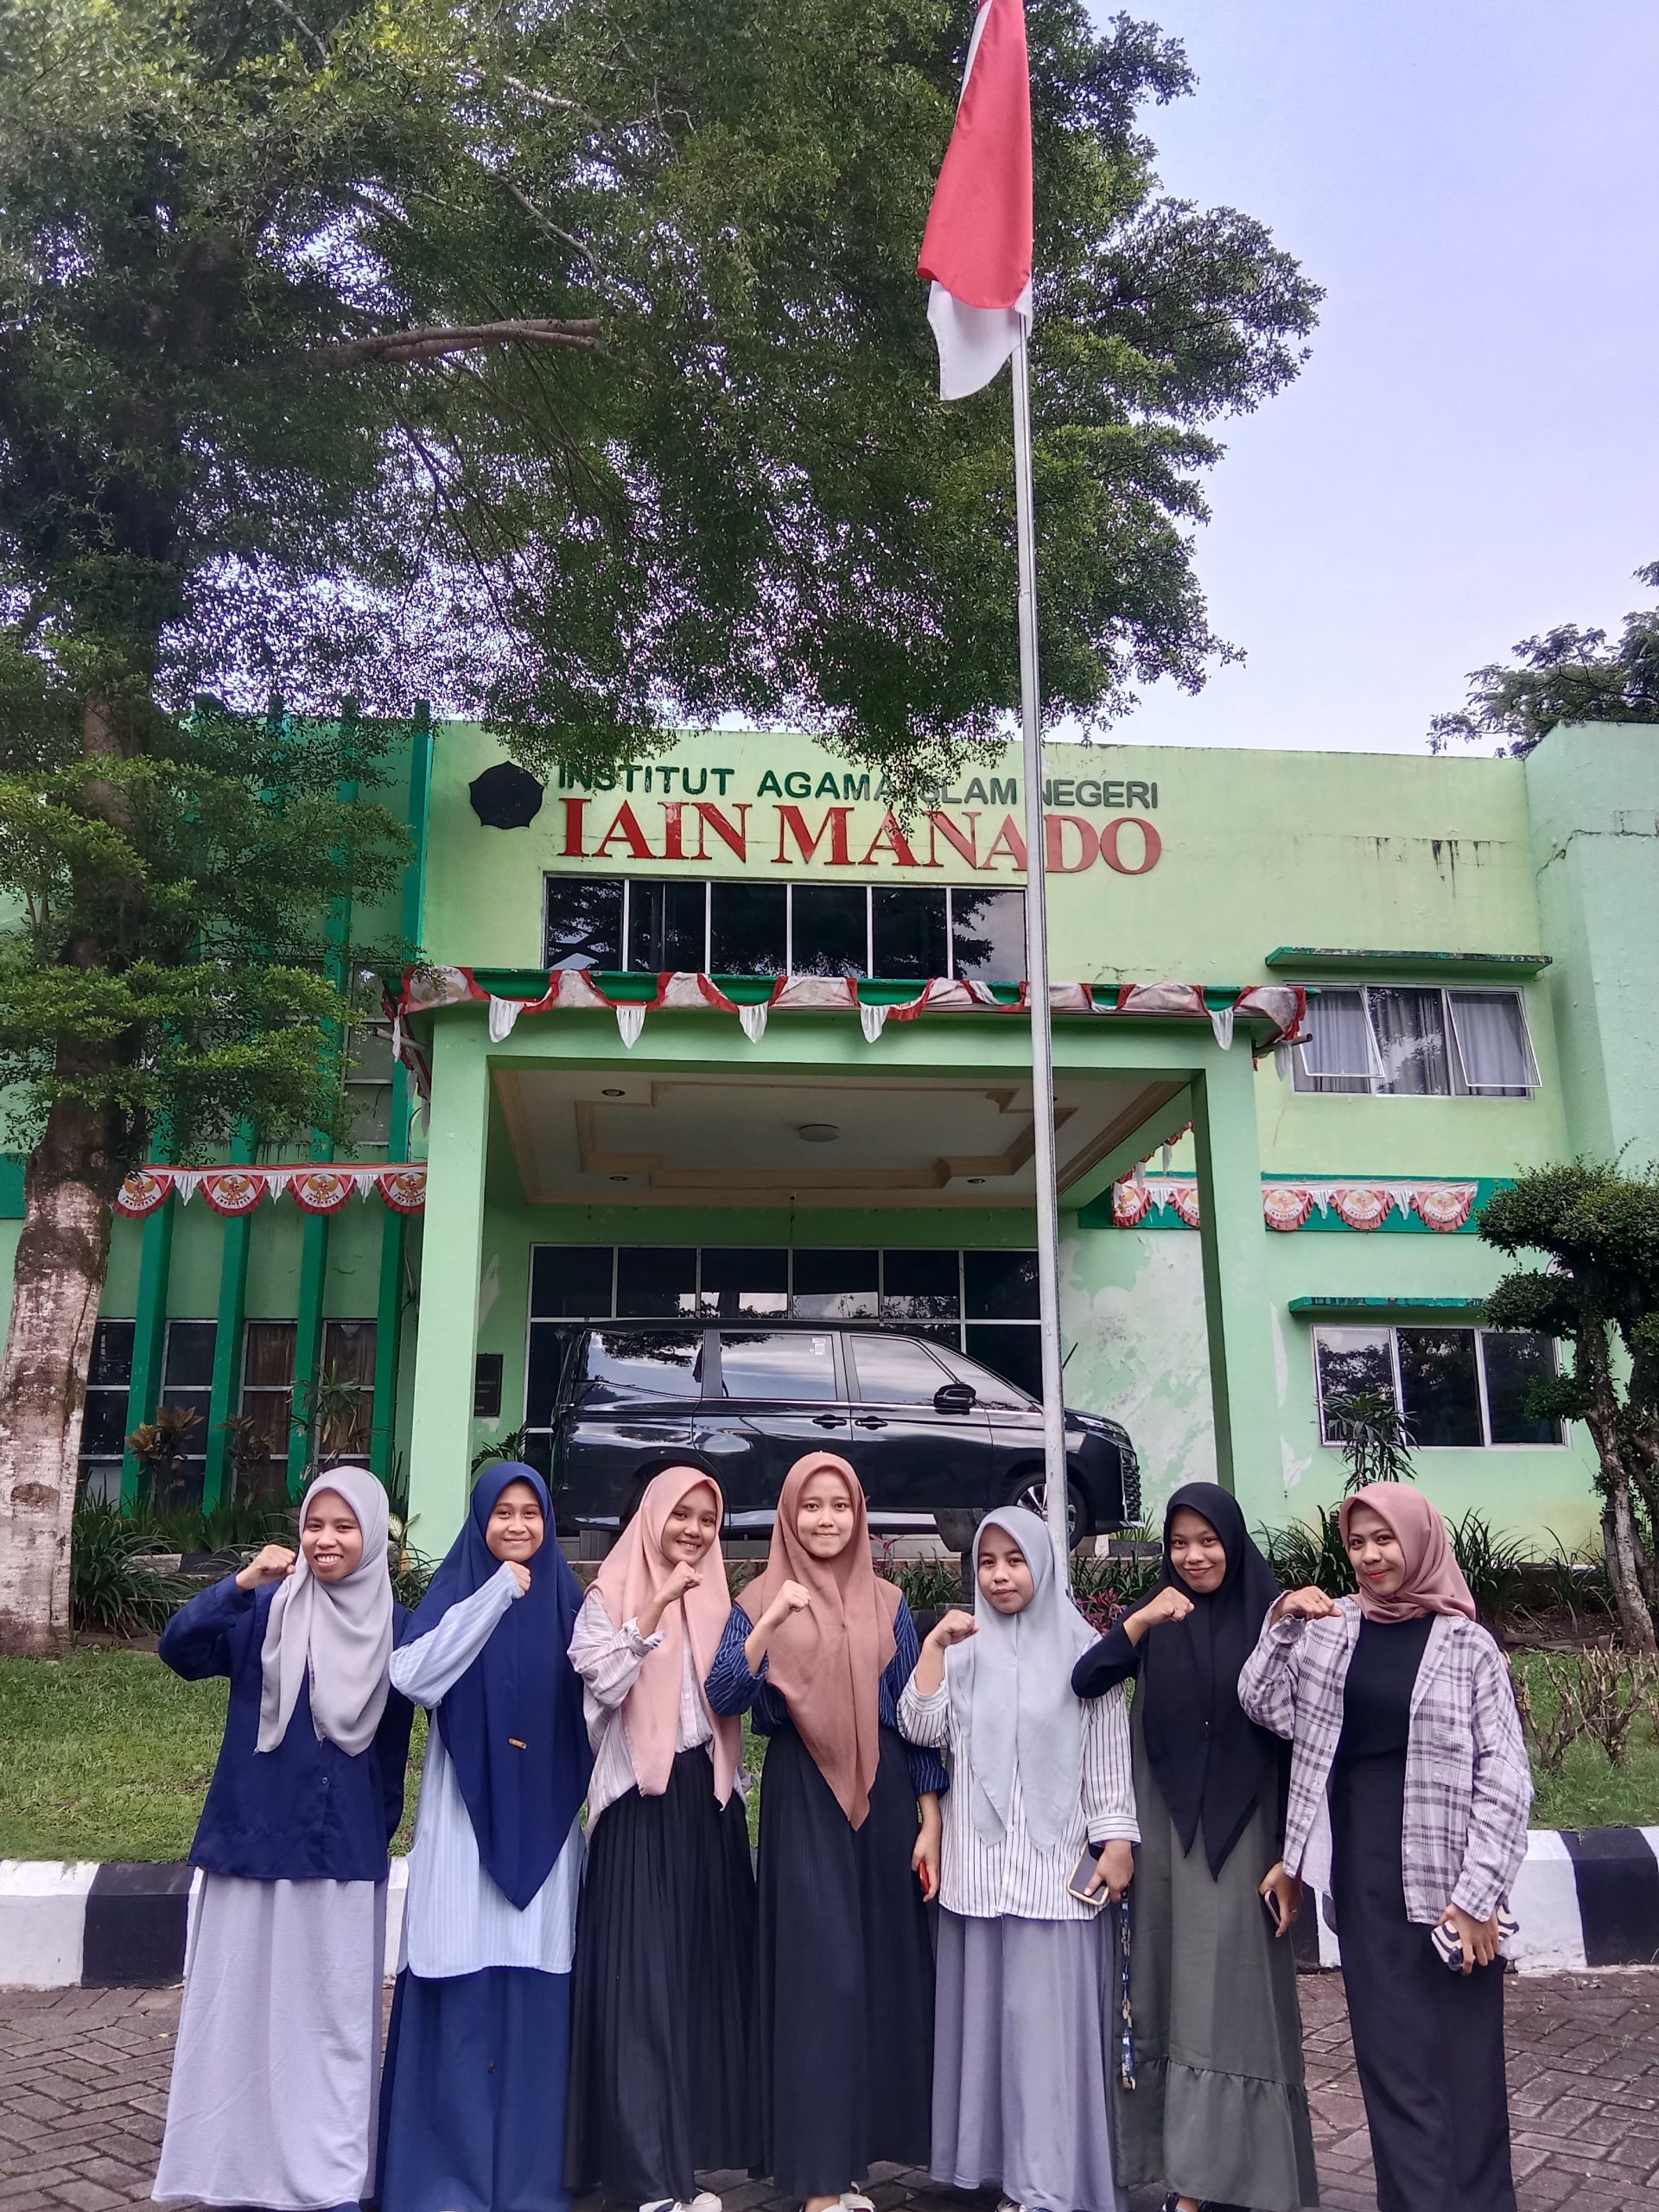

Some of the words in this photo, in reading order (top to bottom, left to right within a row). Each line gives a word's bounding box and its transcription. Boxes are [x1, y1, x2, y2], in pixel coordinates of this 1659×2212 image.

[558, 760, 735, 796] INSTITUT
[757, 769, 898, 802] AGAMA
[556, 797, 753, 864] IAIN
[770, 804, 1162, 875] MANADO
